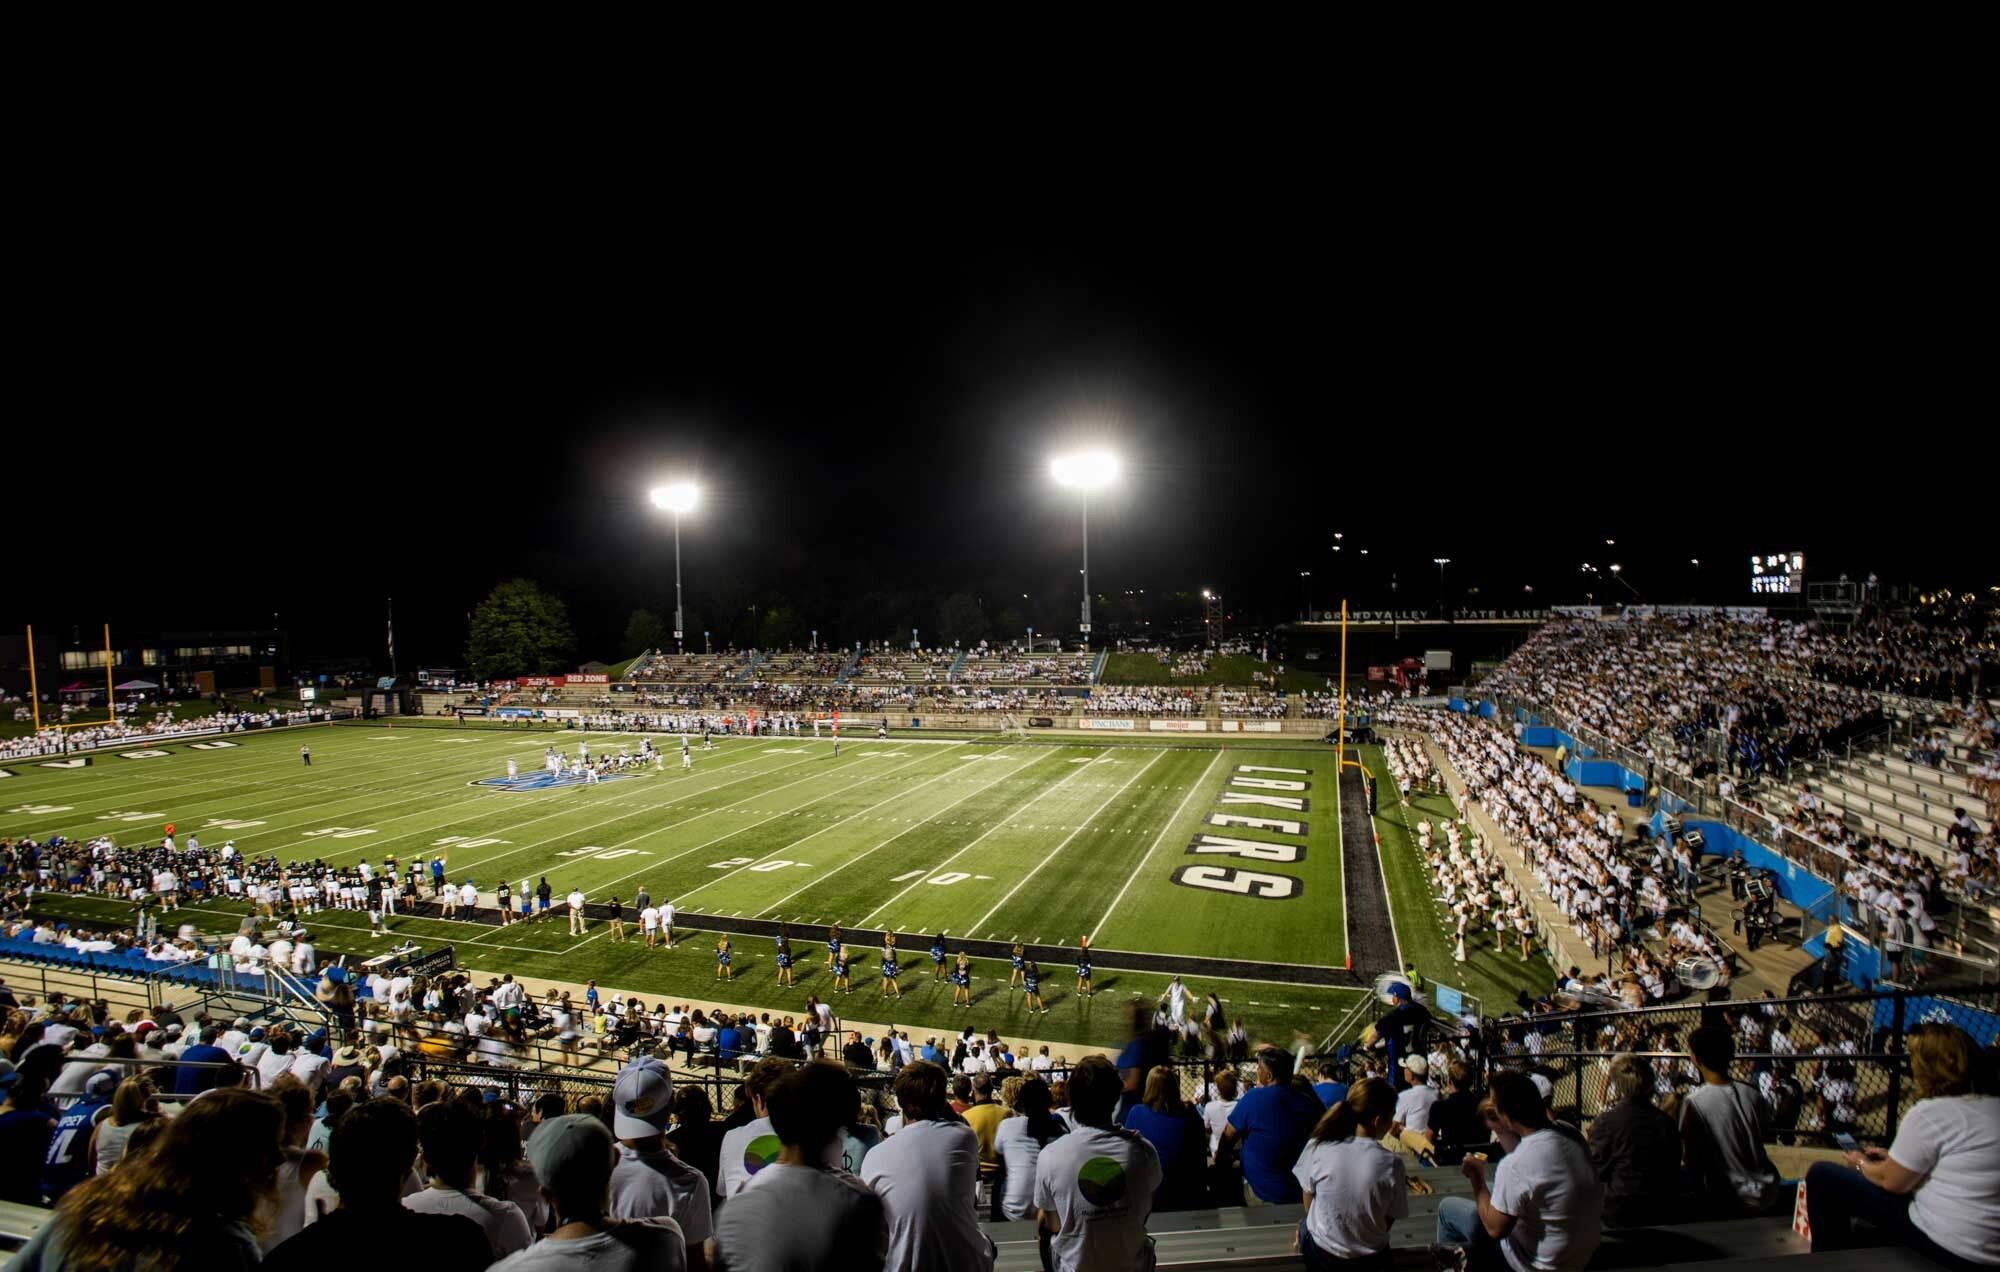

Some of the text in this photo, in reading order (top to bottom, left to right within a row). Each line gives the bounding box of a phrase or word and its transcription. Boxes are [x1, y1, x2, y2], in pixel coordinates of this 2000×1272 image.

[1374, 610, 1428, 620] VALLEY
[1453, 610, 1497, 619] STATE
[567, 675, 584, 683] RED
[44, 745, 56, 754] TO
[301, 826, 378, 838] 50
[1170, 764, 1312, 899] LAKERS
[555, 846, 639, 859] 30
[707, 857, 794, 871] 20
[889, 870, 971, 885] 10
